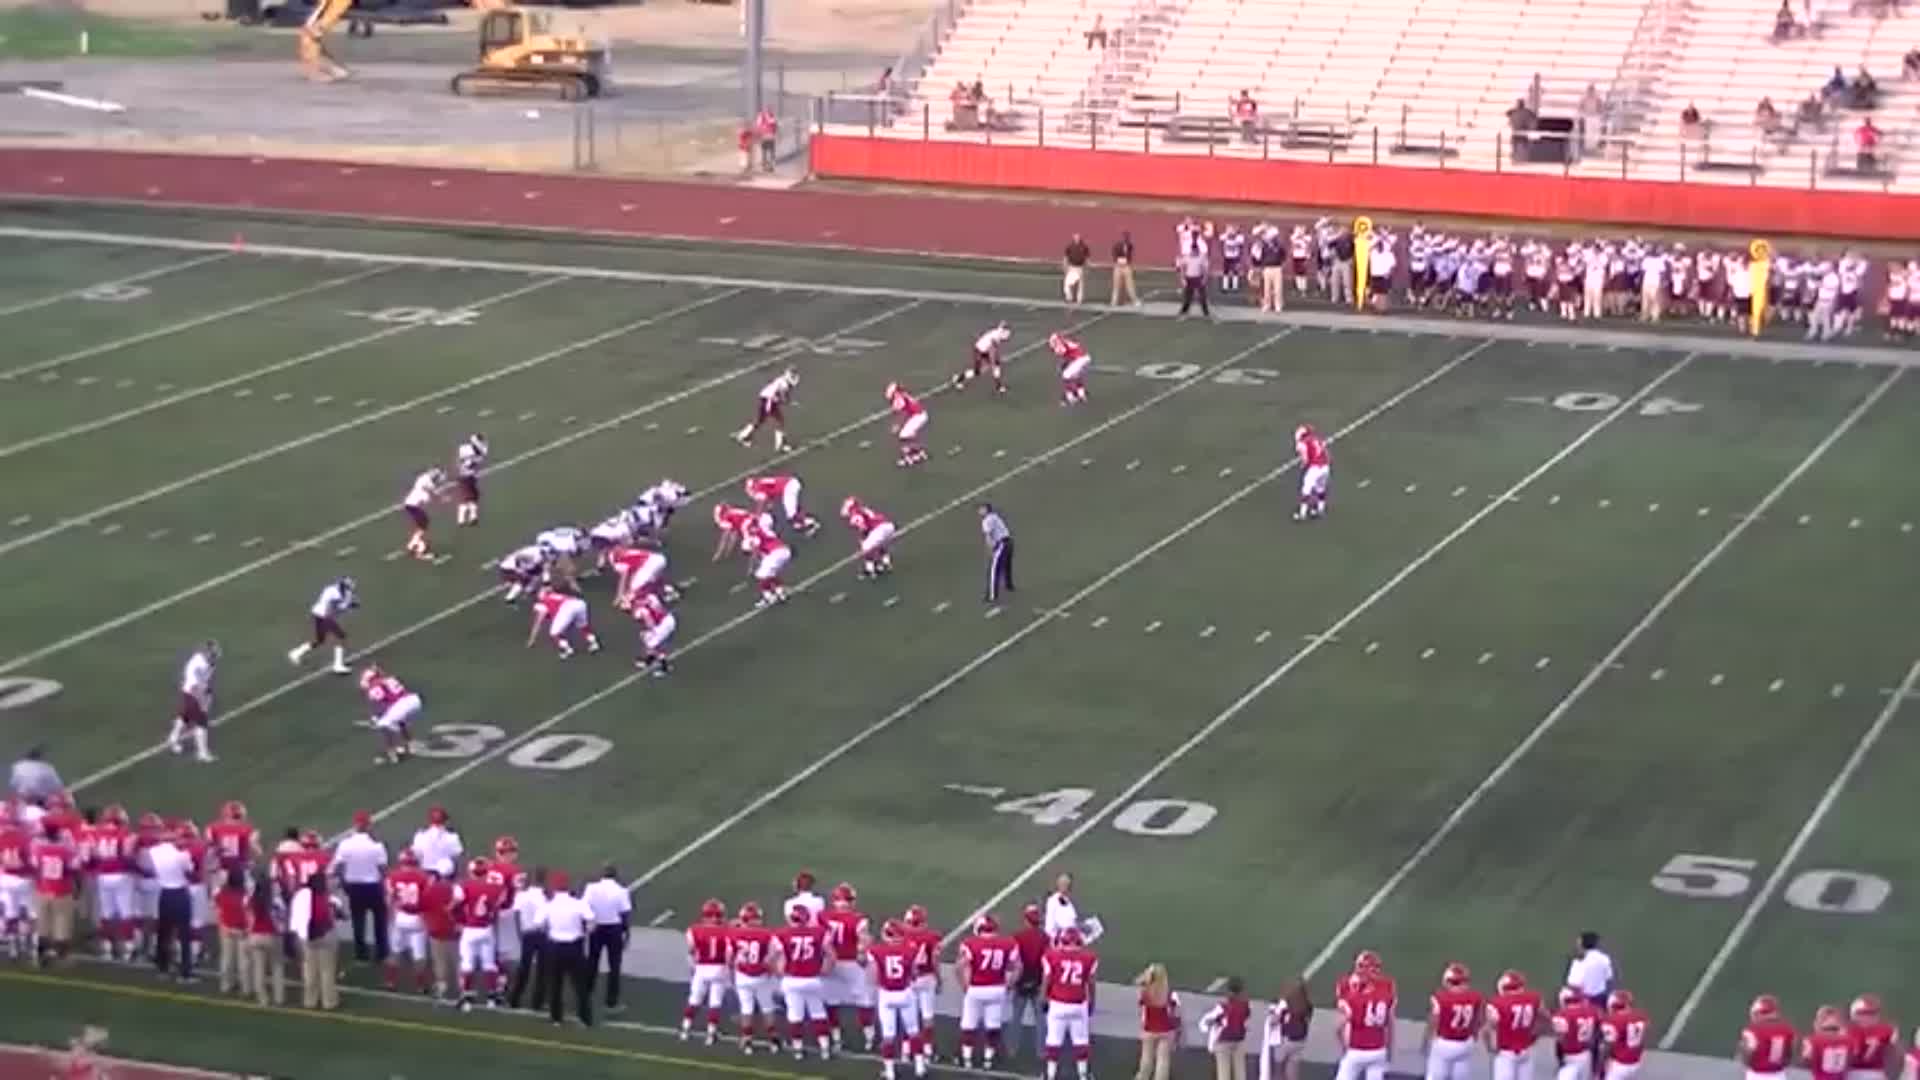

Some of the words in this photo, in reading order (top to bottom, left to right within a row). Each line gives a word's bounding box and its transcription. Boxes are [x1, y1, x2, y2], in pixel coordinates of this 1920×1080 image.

[408, 722, 616, 770] 30
[992, 787, 1219, 836] 40
[1650, 853, 1893, 914] 50
[736, 940, 761, 964] 28
[789, 936, 815, 960] 75
[885, 955, 905, 980] 15
[1059, 960, 1084, 985] 72
